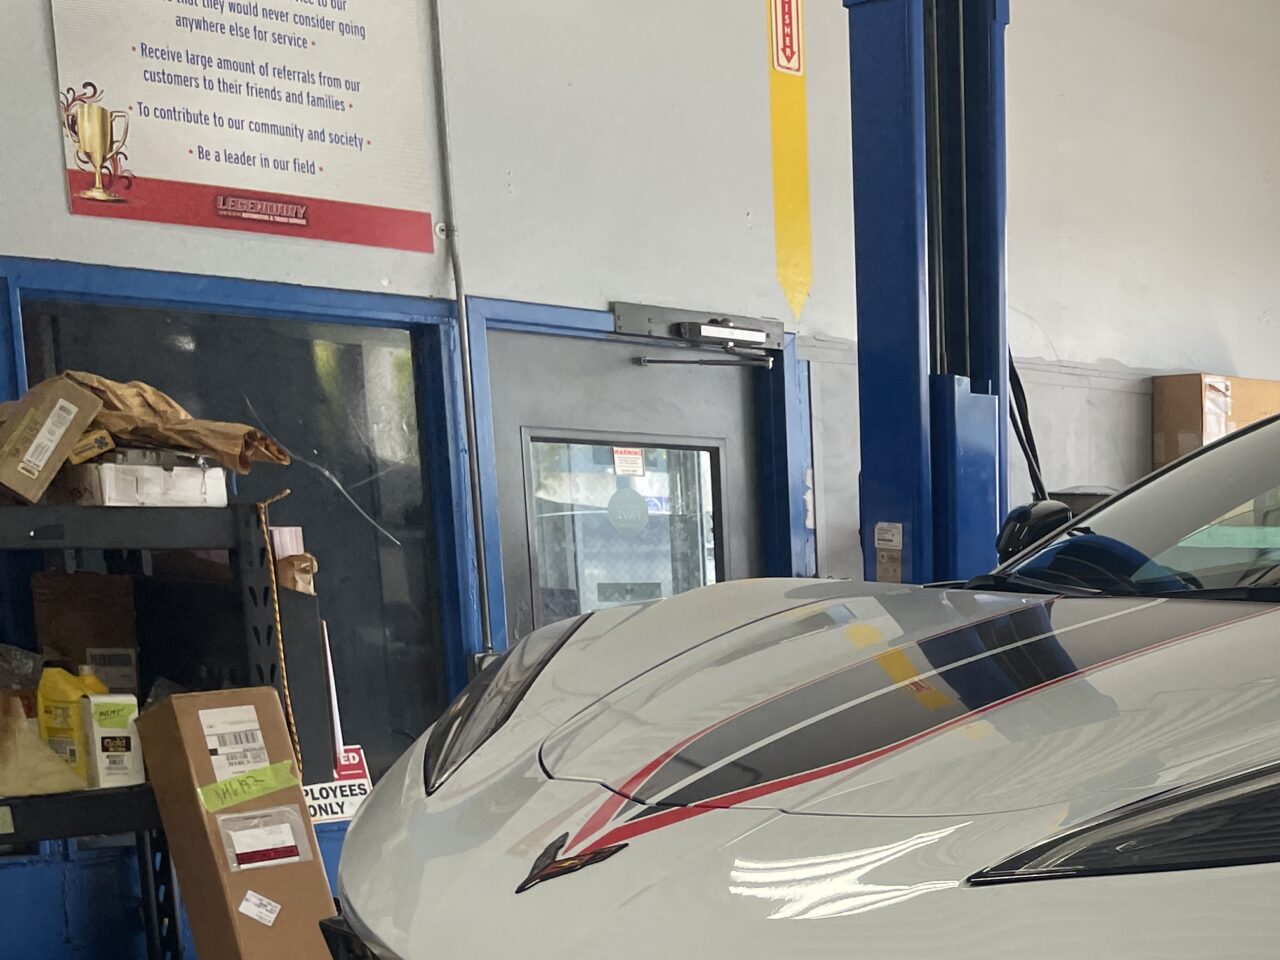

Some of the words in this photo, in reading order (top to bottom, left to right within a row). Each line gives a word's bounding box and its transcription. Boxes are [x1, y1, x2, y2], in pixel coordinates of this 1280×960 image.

[202, 0, 225, 15] they
[228, 2, 259, 18] would
[262, 9, 289, 23] never
[293, 13, 336, 32] consider
[338, 21, 366, 40] going
[331, 0, 346, 11] our
[175, 15, 226, 36] anywhere
[229, 20, 250, 39] else
[253, 26, 268, 42] for
[271, 31, 308, 49] service
[784, 0, 792, 58] ISHER
[140, 42, 183, 63] Receive
[186, 49, 213, 70] large
[217, 57, 256, 75] amount
[259, 62, 270, 77] of
[272, 65, 316, 85] referrals
[319, 72, 342, 89] from
[345, 79, 361, 93] our
[143, 68, 200, 89] customers
[203, 76, 214, 91] to
[217, 78, 242, 96] their
[246, 82, 282, 102] friends
[285, 91, 304, 106] and
[307, 92, 346, 112] families
[136, 101, 150, 118] To
[153, 106, 210, 126] contribute
[213, 112, 225, 128] to
[228, 117, 244, 131] our
[249, 120, 304, 143] community
[308, 127, 326, 143] and
[329, 131, 364, 151] society
[198, 145, 211, 161] Be
[214, 152, 221, 162] a
[224, 149, 256, 167] leader
[260, 154, 270, 168] in
[273, 158, 289, 171] our
[293, 158, 316, 175] field
[341, 752, 360, 765] ED
[309, 801, 345, 817] ONLY
